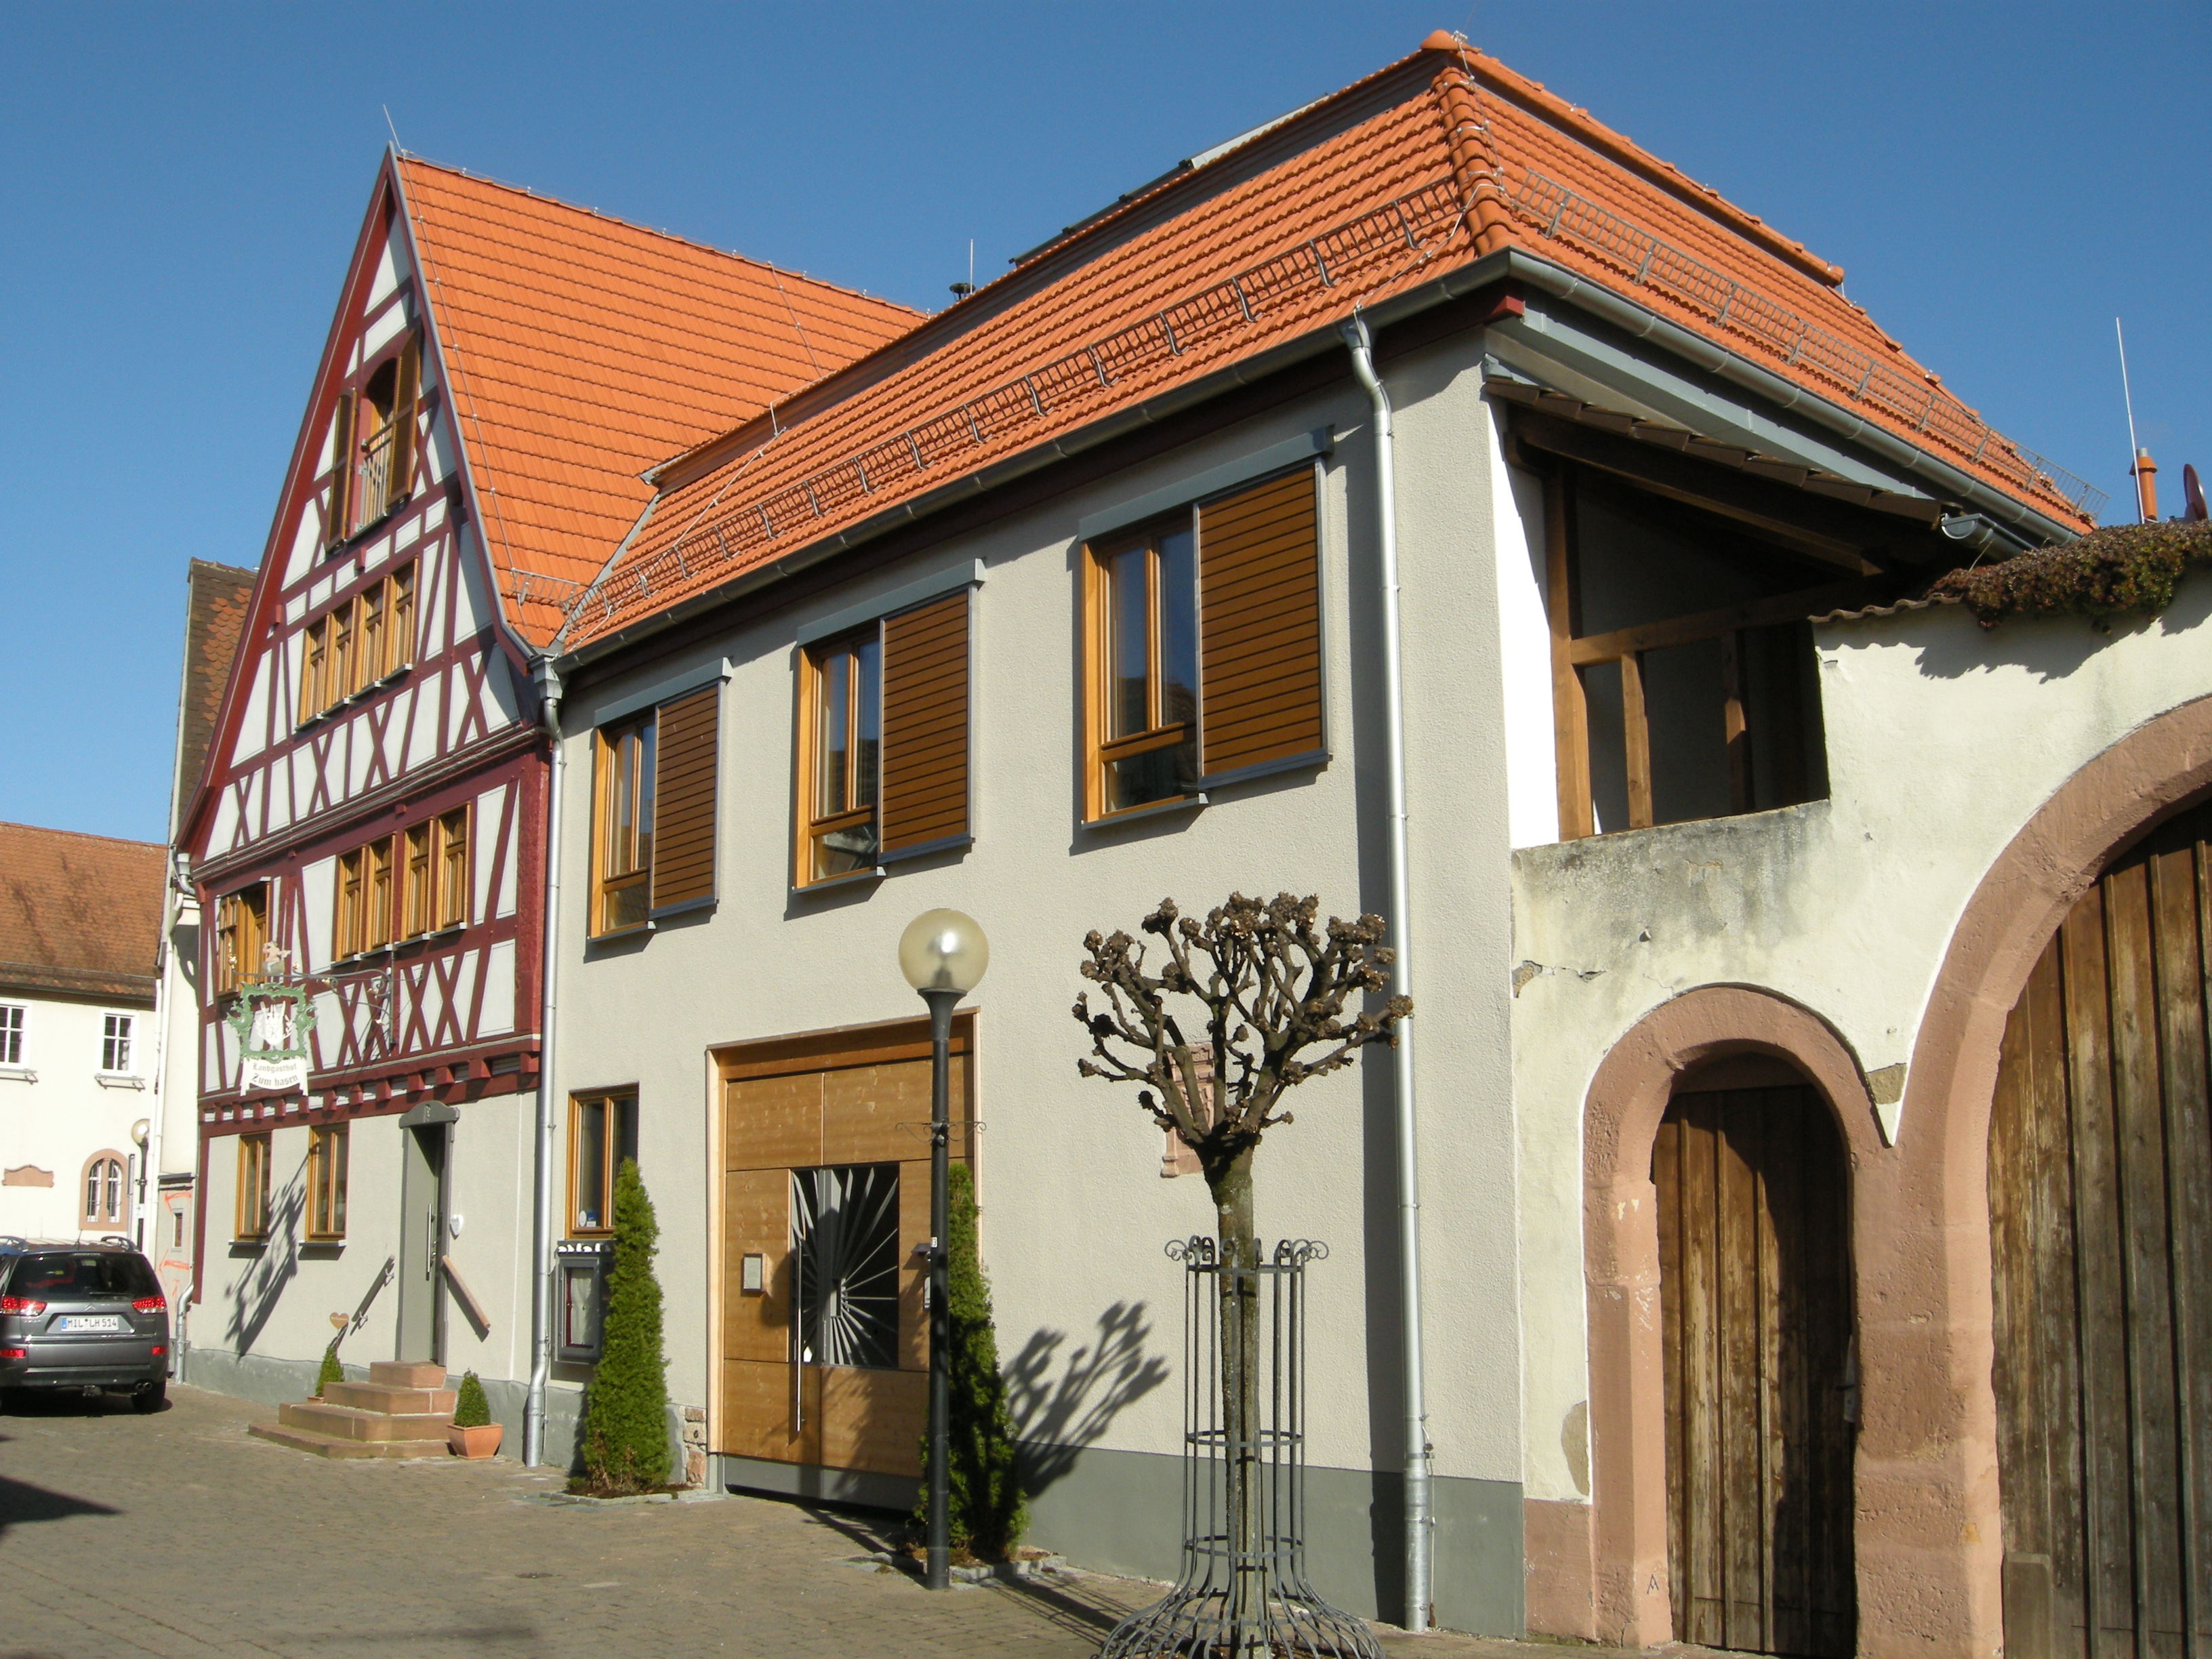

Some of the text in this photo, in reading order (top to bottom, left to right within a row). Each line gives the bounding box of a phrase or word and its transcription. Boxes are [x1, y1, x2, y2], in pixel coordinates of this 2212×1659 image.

[253, 1062, 297, 1073] Landgasthof
[251, 1073, 271, 1086] Zum
[68, 1318, 117, 1328] MIL LH 514
